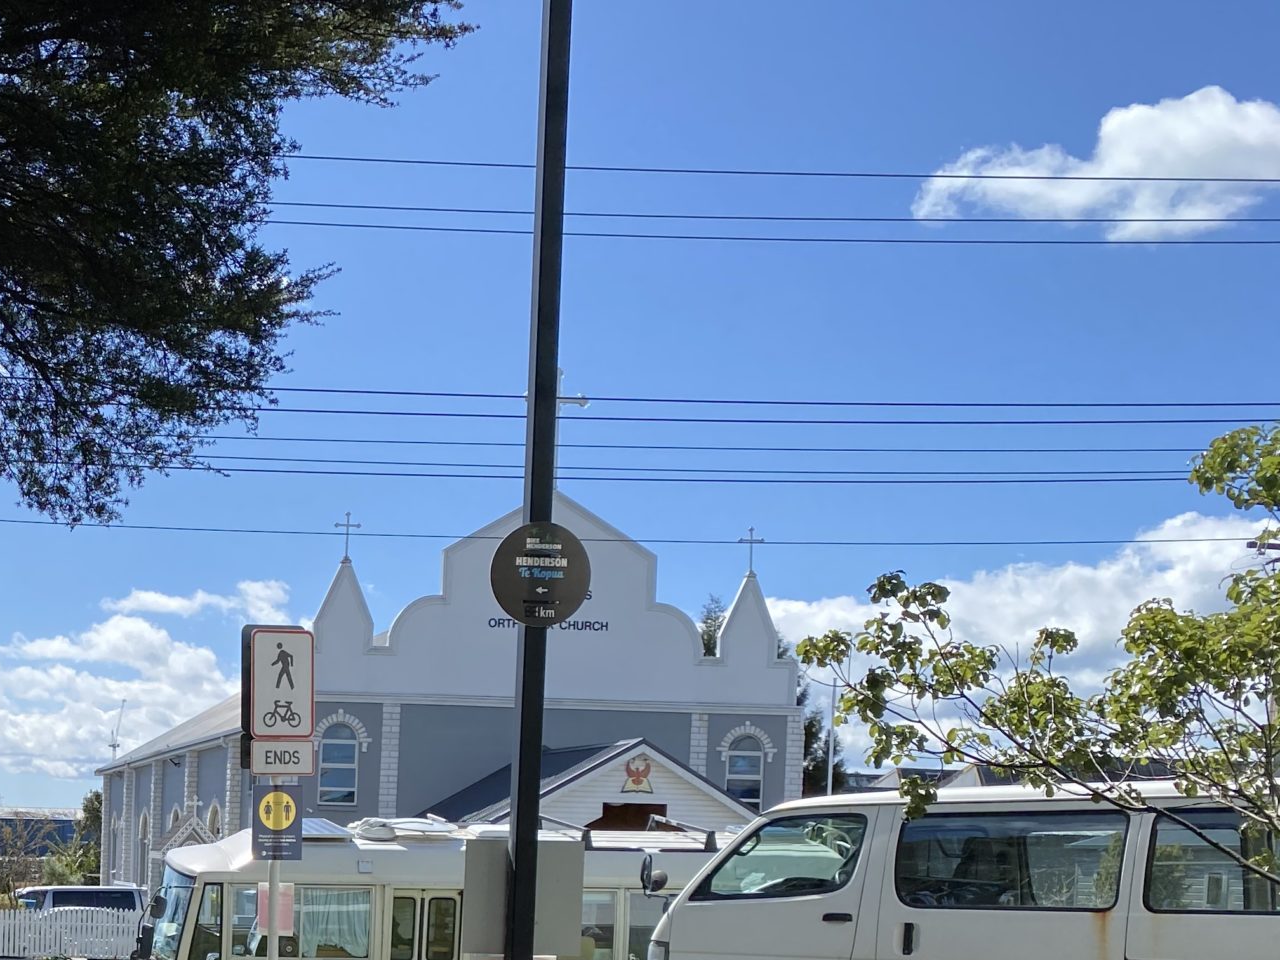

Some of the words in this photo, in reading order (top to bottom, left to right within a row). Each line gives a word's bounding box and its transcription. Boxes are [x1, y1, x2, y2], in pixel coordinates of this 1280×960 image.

[515, 556, 568, 567] HENDERSON
[519, 567, 530, 578] Te
[531, 567, 564, 581] Kopua
[559, 620, 609, 632] CHURCH
[265, 750, 301, 765] ENDS
